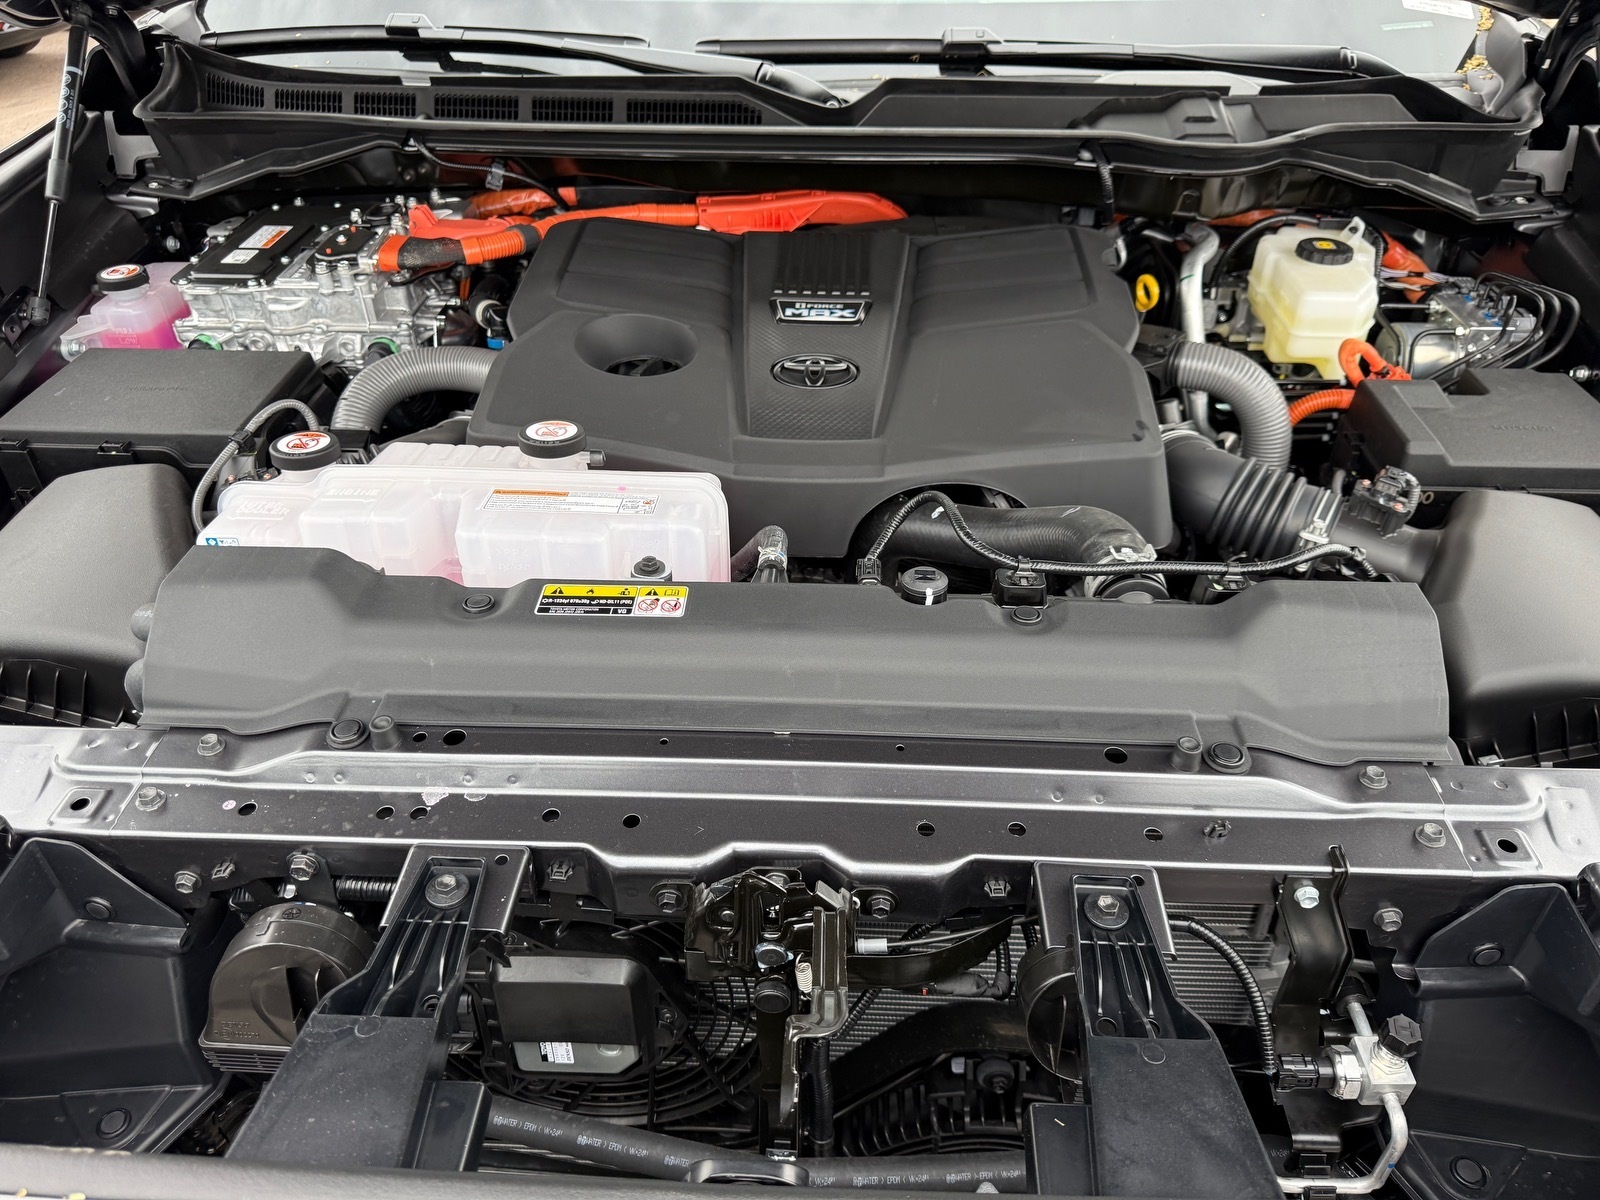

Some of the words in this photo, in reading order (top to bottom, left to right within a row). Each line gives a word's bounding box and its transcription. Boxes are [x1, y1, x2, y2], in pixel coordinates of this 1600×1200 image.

[784, 308, 856, 317] MAX
[119, 337, 138, 345] LOW
[326, 488, 381, 497] ENGINE
